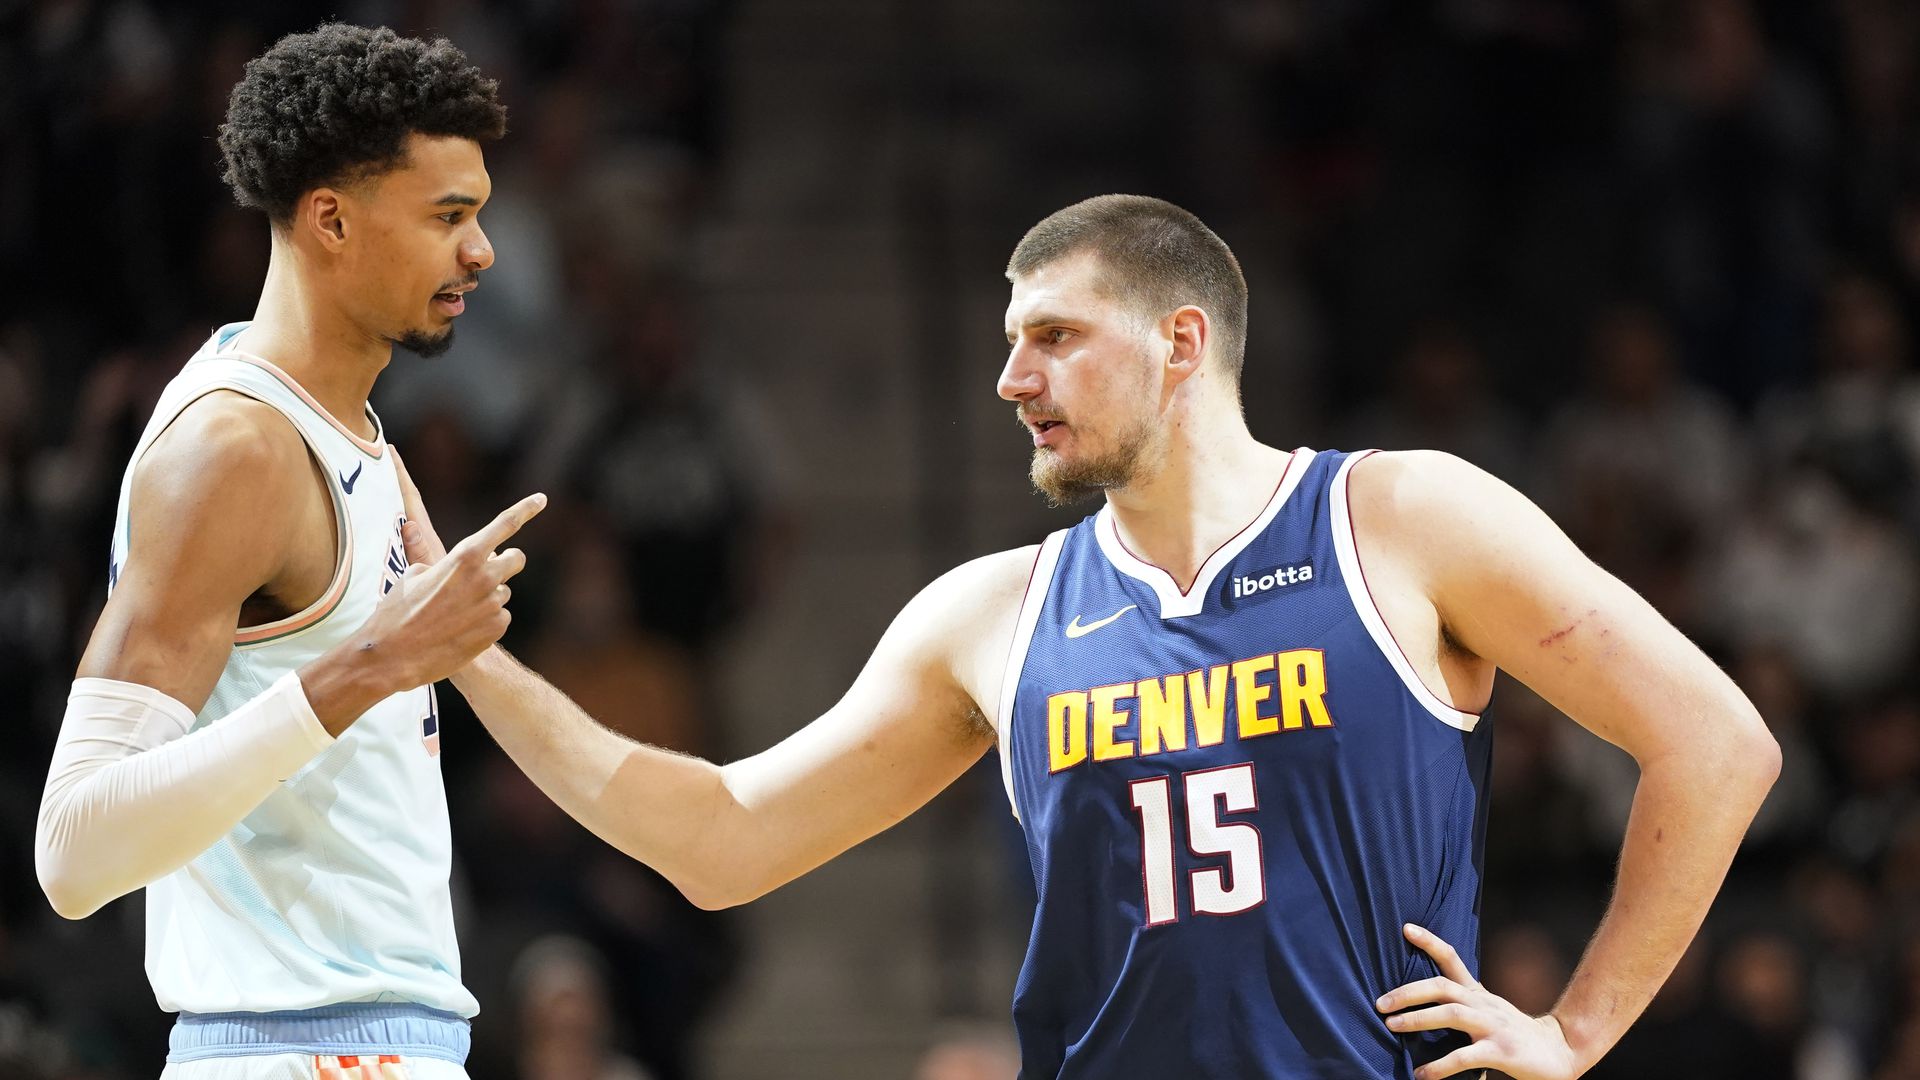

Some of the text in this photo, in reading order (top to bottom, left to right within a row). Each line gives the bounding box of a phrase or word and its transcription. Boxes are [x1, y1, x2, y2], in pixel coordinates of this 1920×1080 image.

[1234, 564, 1312, 598] ibotta
[1048, 648, 1334, 774] DENVER
[1128, 762, 1266, 928] 15
